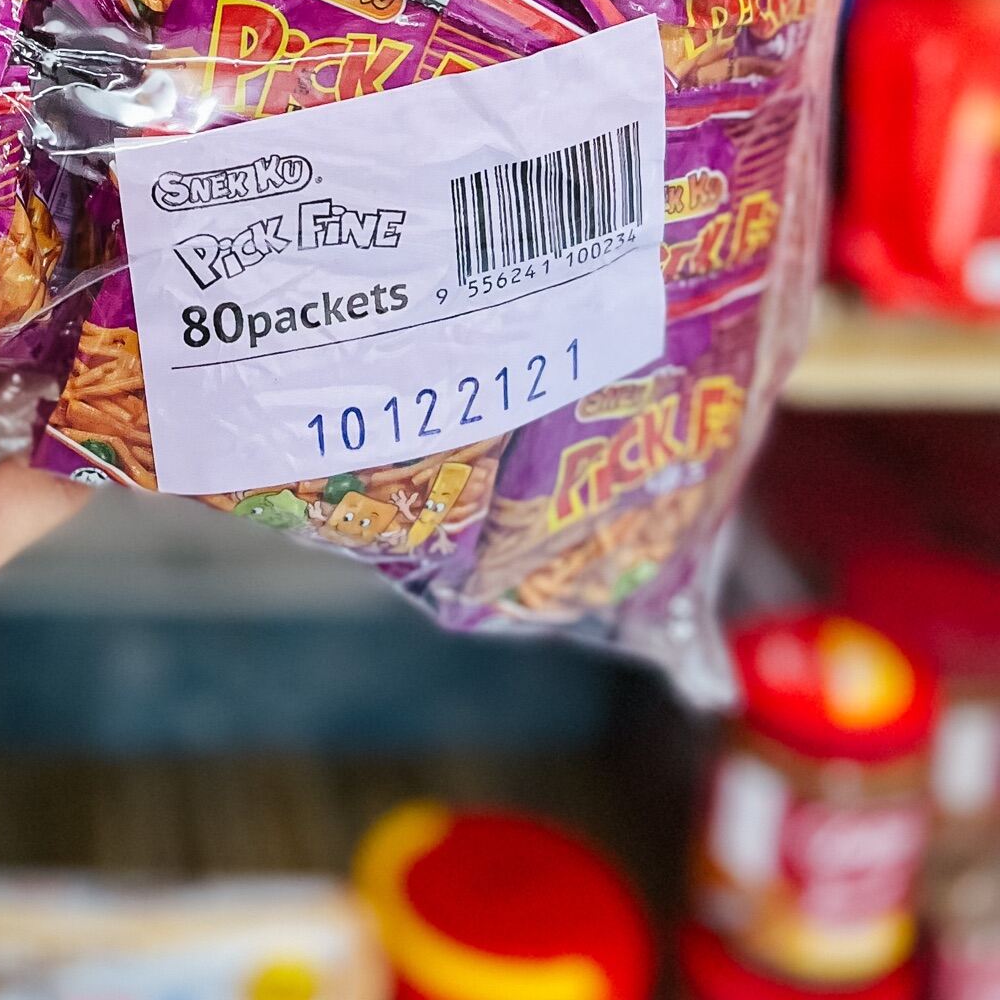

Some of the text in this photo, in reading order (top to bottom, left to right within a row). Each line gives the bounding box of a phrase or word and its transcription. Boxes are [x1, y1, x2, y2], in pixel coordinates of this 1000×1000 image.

[157, 155, 304, 206] SNEK KU
[435, 229, 637, 305] 9 556241 100234
[182, 282, 409, 349] 80packets
